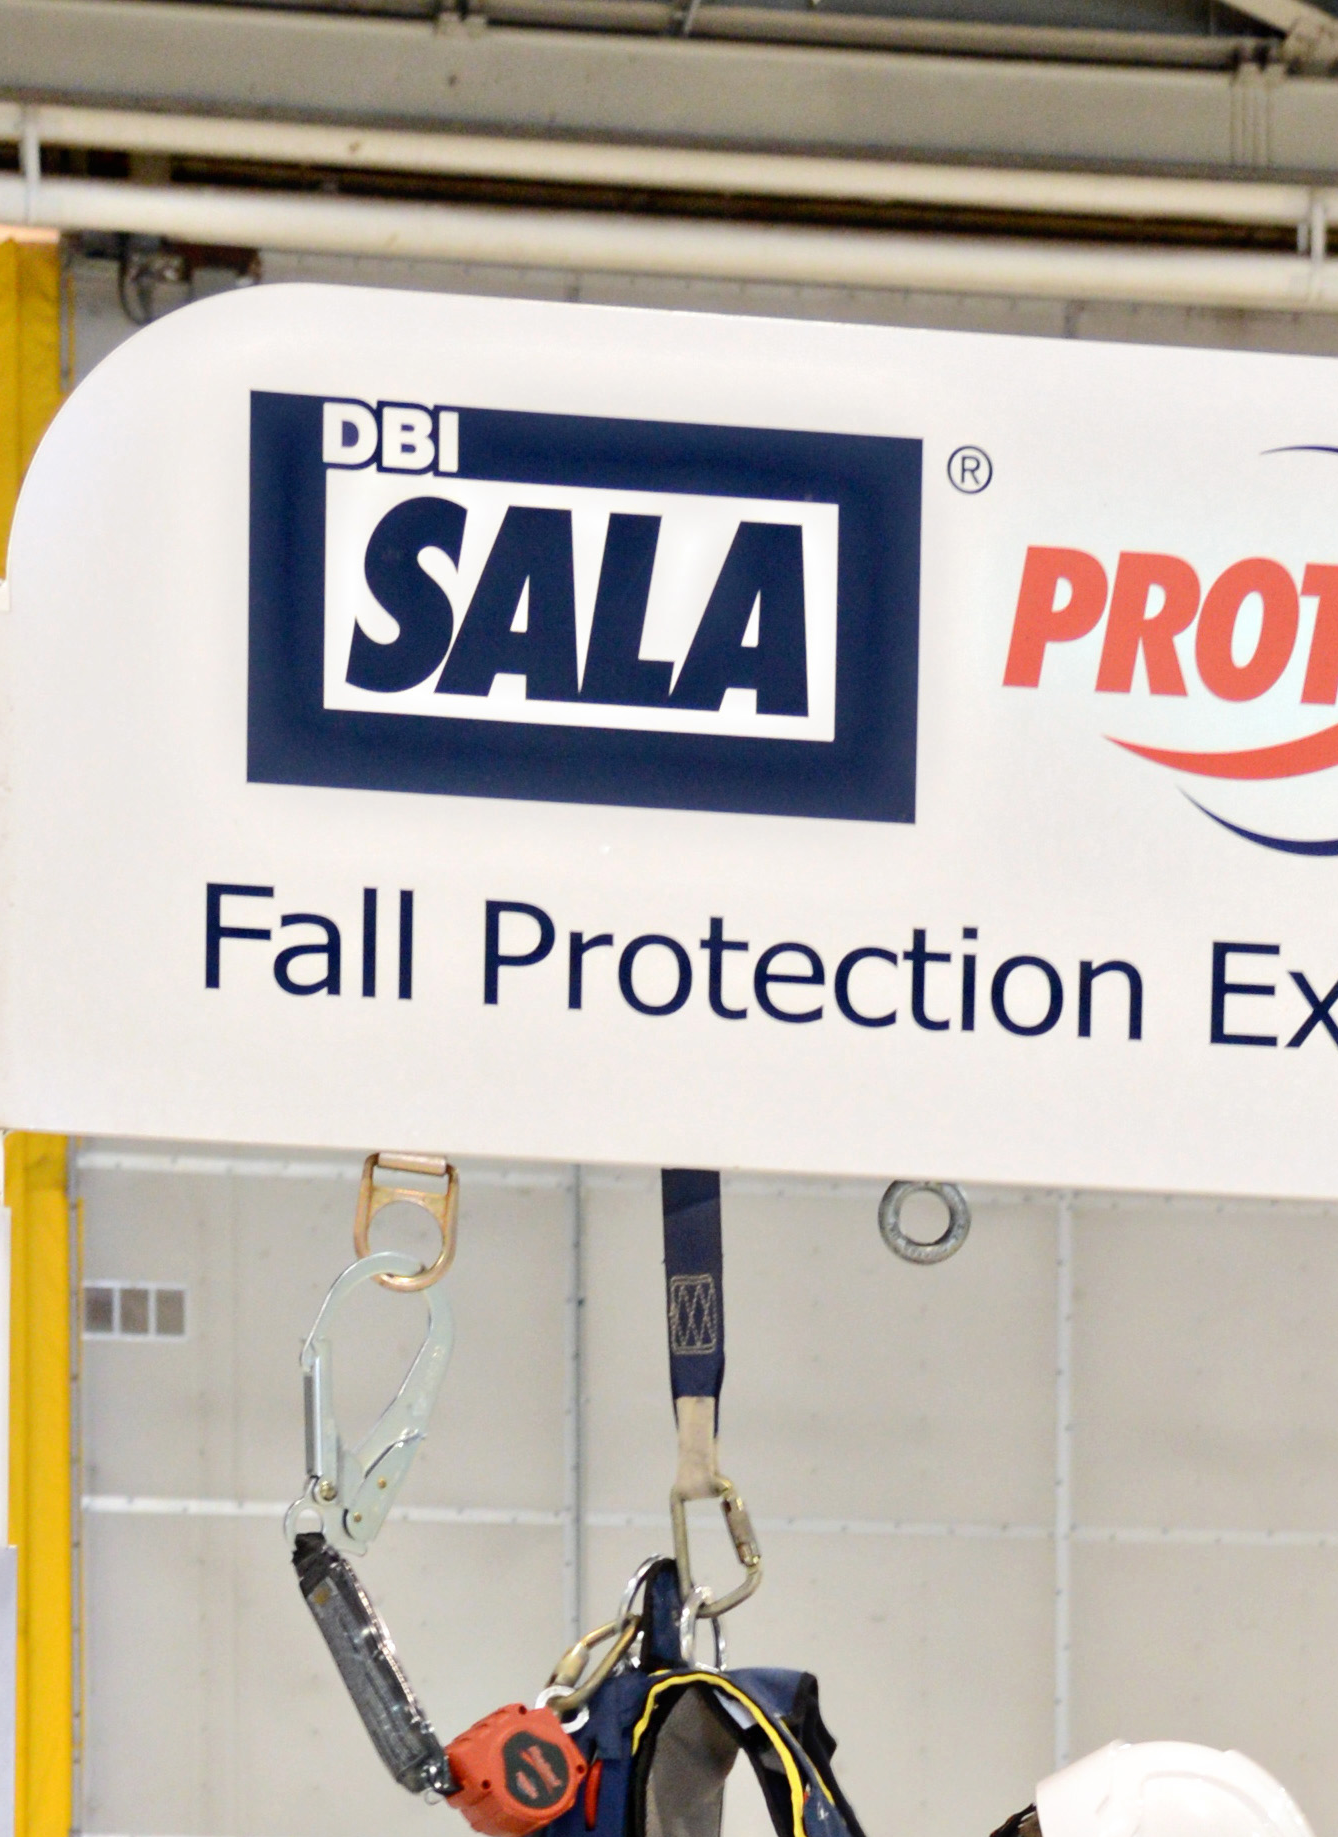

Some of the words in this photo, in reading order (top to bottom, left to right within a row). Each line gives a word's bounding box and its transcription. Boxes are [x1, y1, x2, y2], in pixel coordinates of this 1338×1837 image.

[322, 401, 459, 473] DBI
[346, 496, 809, 717] SALA
[206, 883, 413, 1000] Fall
[484, 900, 1143, 1041] Protection
